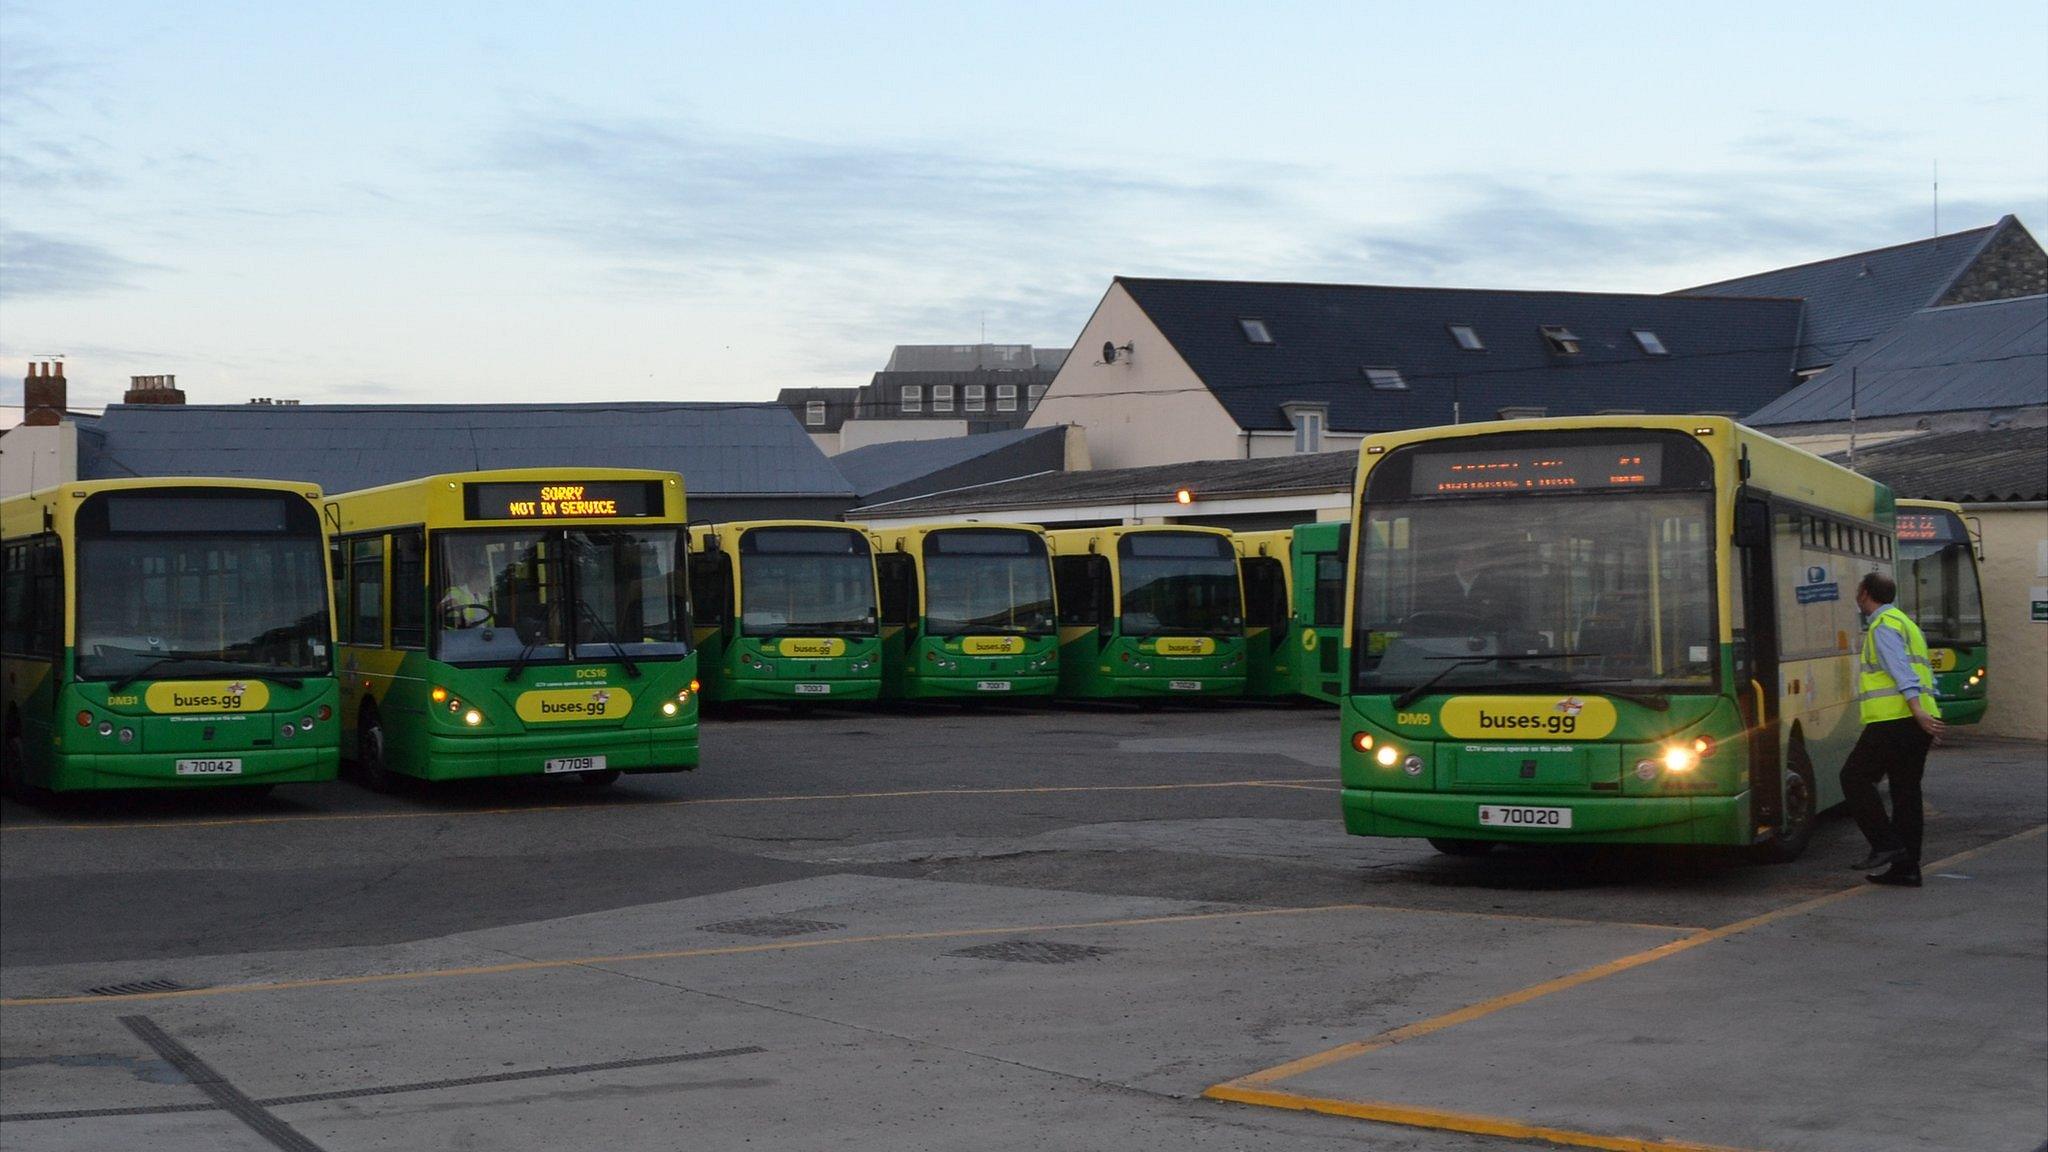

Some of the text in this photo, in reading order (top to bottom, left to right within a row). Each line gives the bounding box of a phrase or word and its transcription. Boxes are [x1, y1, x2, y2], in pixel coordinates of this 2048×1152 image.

[541, 486, 584, 500] SORRY
[510, 500, 616, 515] NOT IN SERVICE
[793, 644, 831, 655] buses.gg
[976, 642, 1011, 652] buses.gg
[576, 669, 607, 678] DCS16
[107, 696, 138, 705] DM31
[173, 693, 241, 709] buses.gg
[541, 700, 605, 715] buses.gg
[1397, 713, 1432, 725] DM9
[1480, 711, 1576, 733] buses.gg
[191, 761, 233, 773] 70042
[558, 758, 593, 770] 77091
[1500, 808, 1559, 825] 70020
